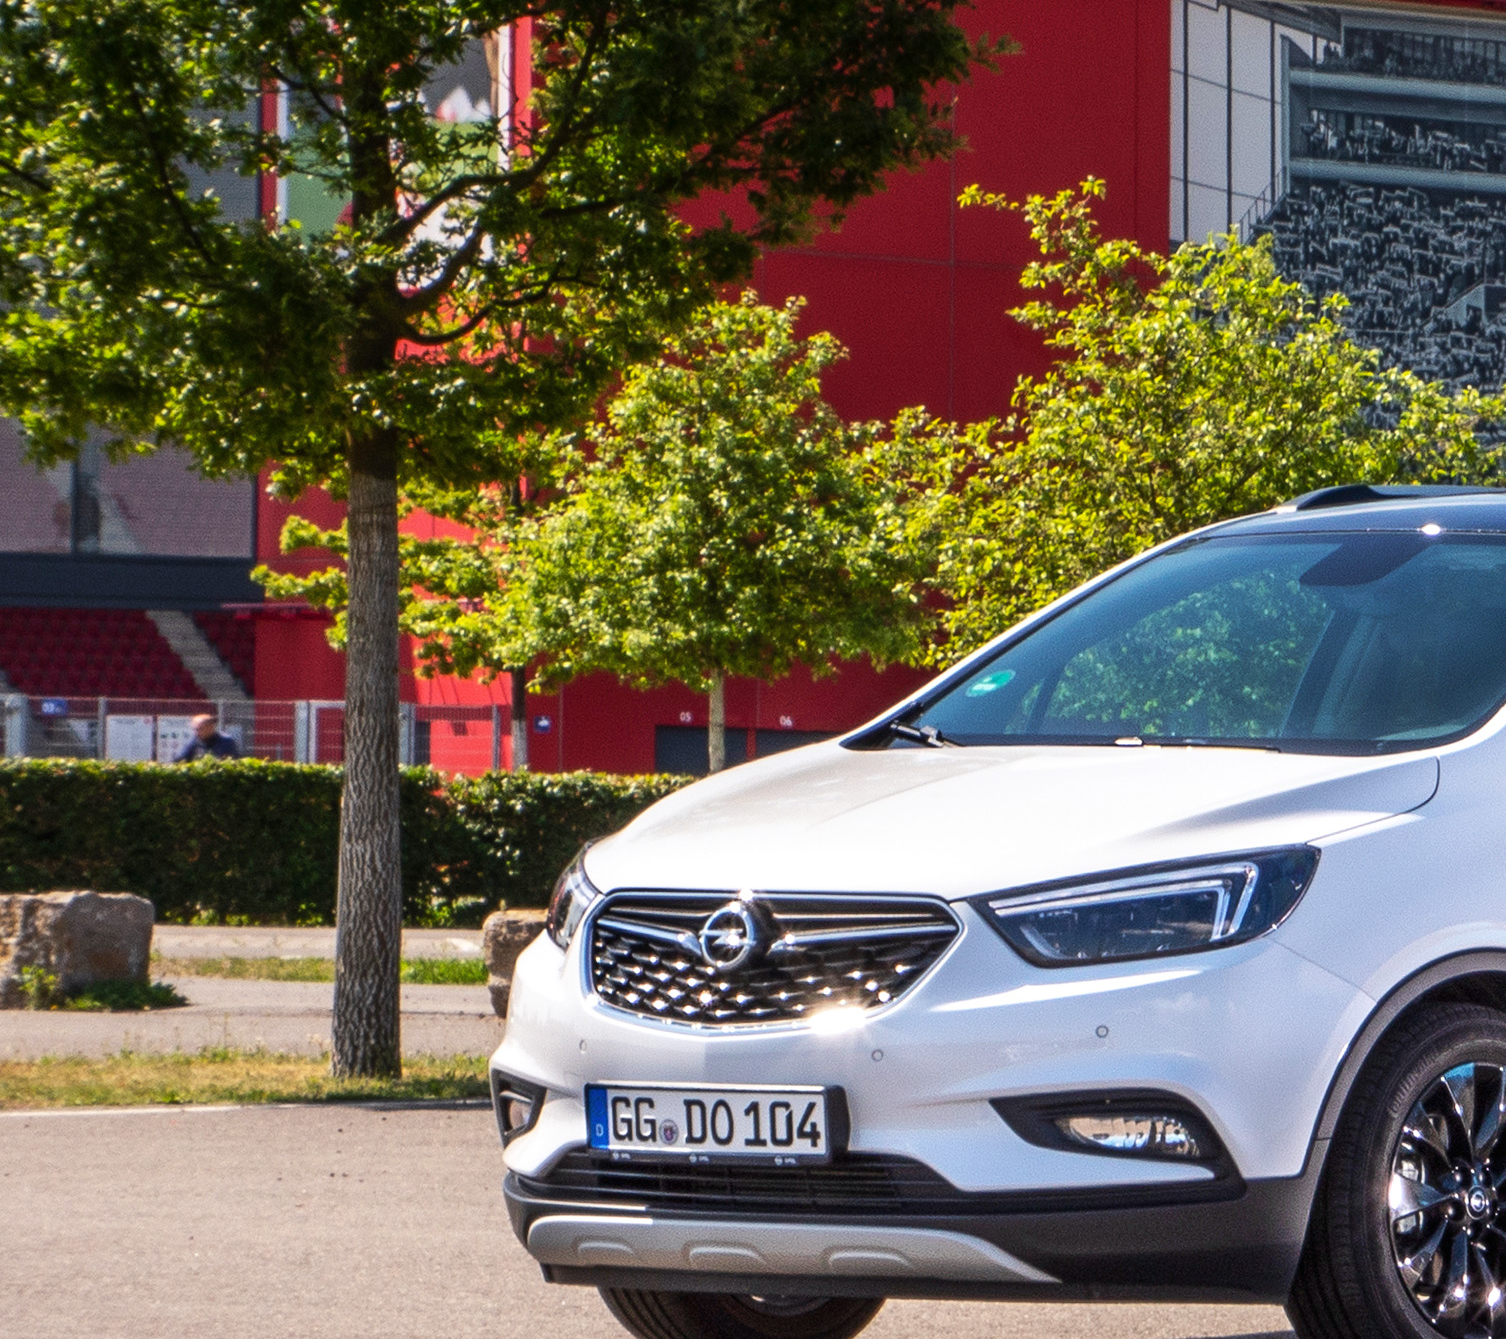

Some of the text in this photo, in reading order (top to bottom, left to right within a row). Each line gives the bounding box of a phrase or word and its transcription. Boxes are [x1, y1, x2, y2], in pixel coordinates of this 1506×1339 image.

[611, 1096, 657, 1142] GG
[683, 1099, 734, 1146] DO
[744, 1101, 821, 1148] 104
